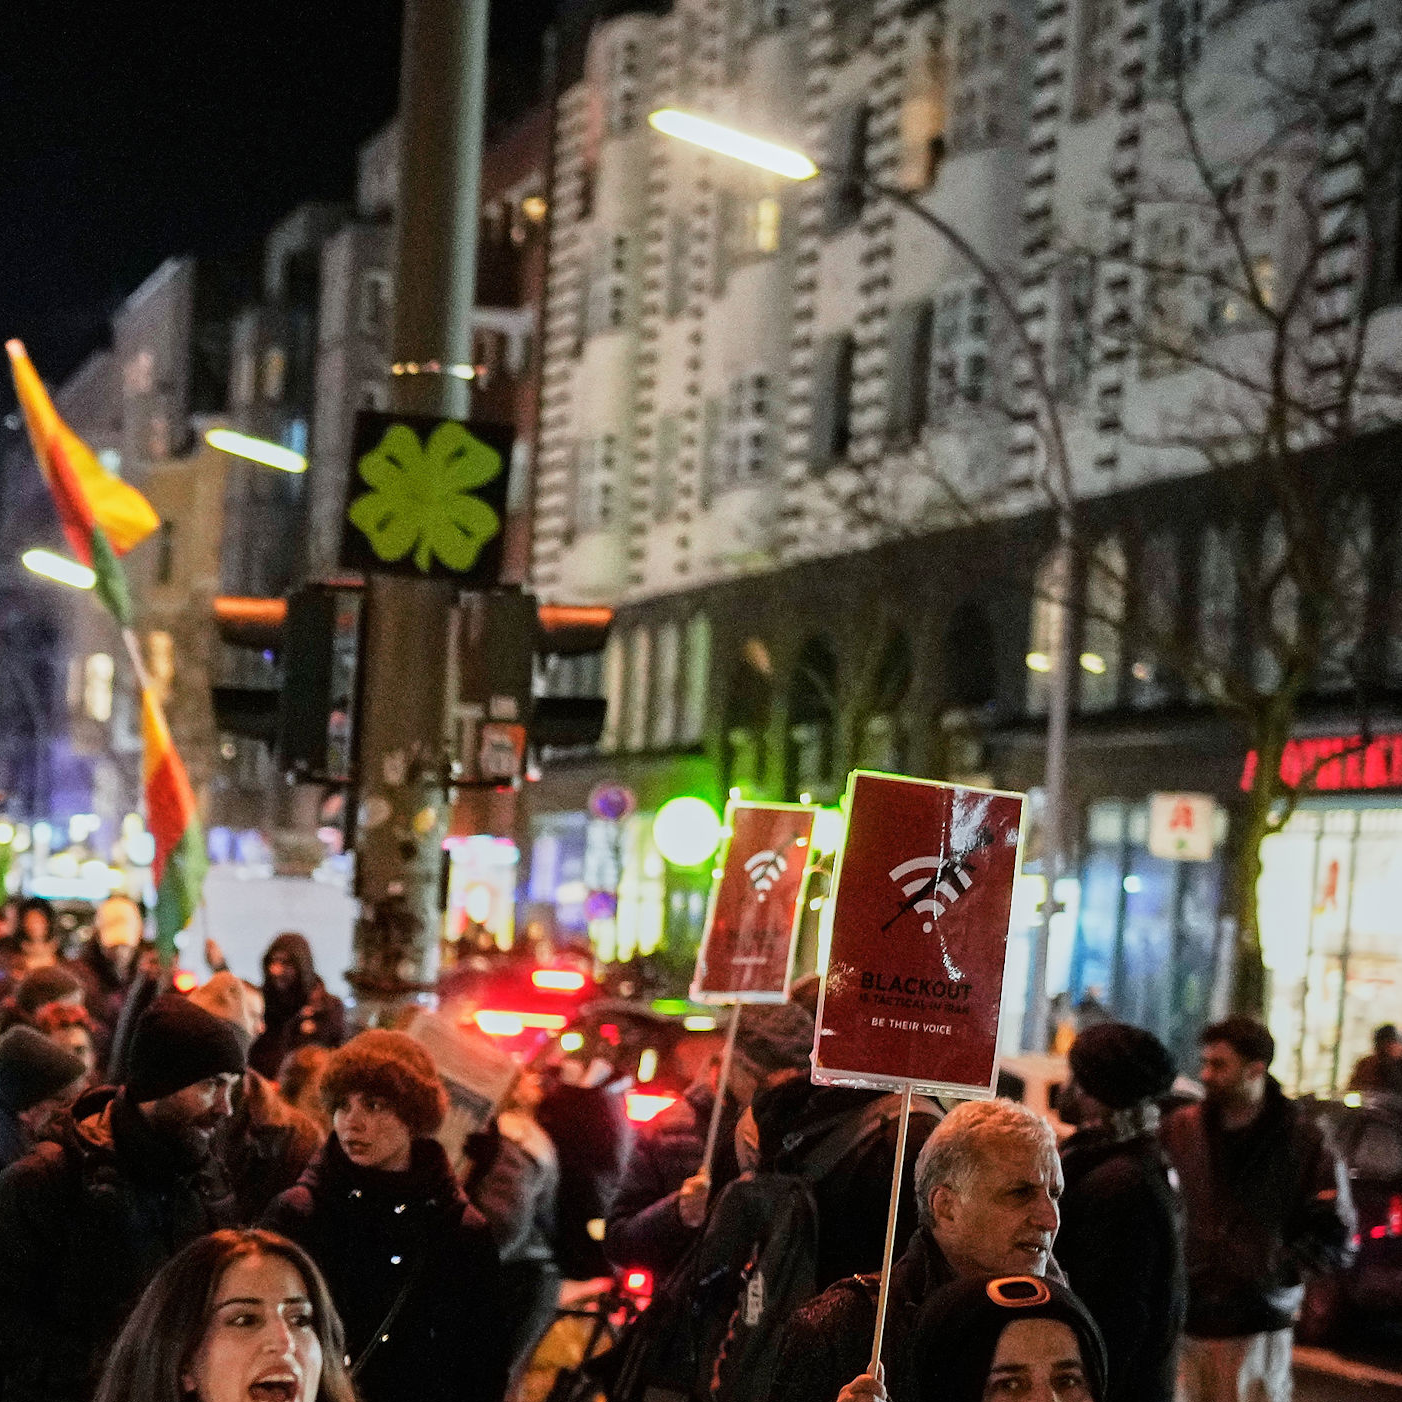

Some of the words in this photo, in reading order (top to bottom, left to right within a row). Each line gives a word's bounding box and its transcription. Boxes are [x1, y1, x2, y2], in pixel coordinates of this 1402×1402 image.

[860, 971, 973, 1001] BLACKOUT
[871, 1017, 885, 1027] BE
[889, 1019, 920, 1032] THEIR
[923, 1023, 952, 1035] VOICE
